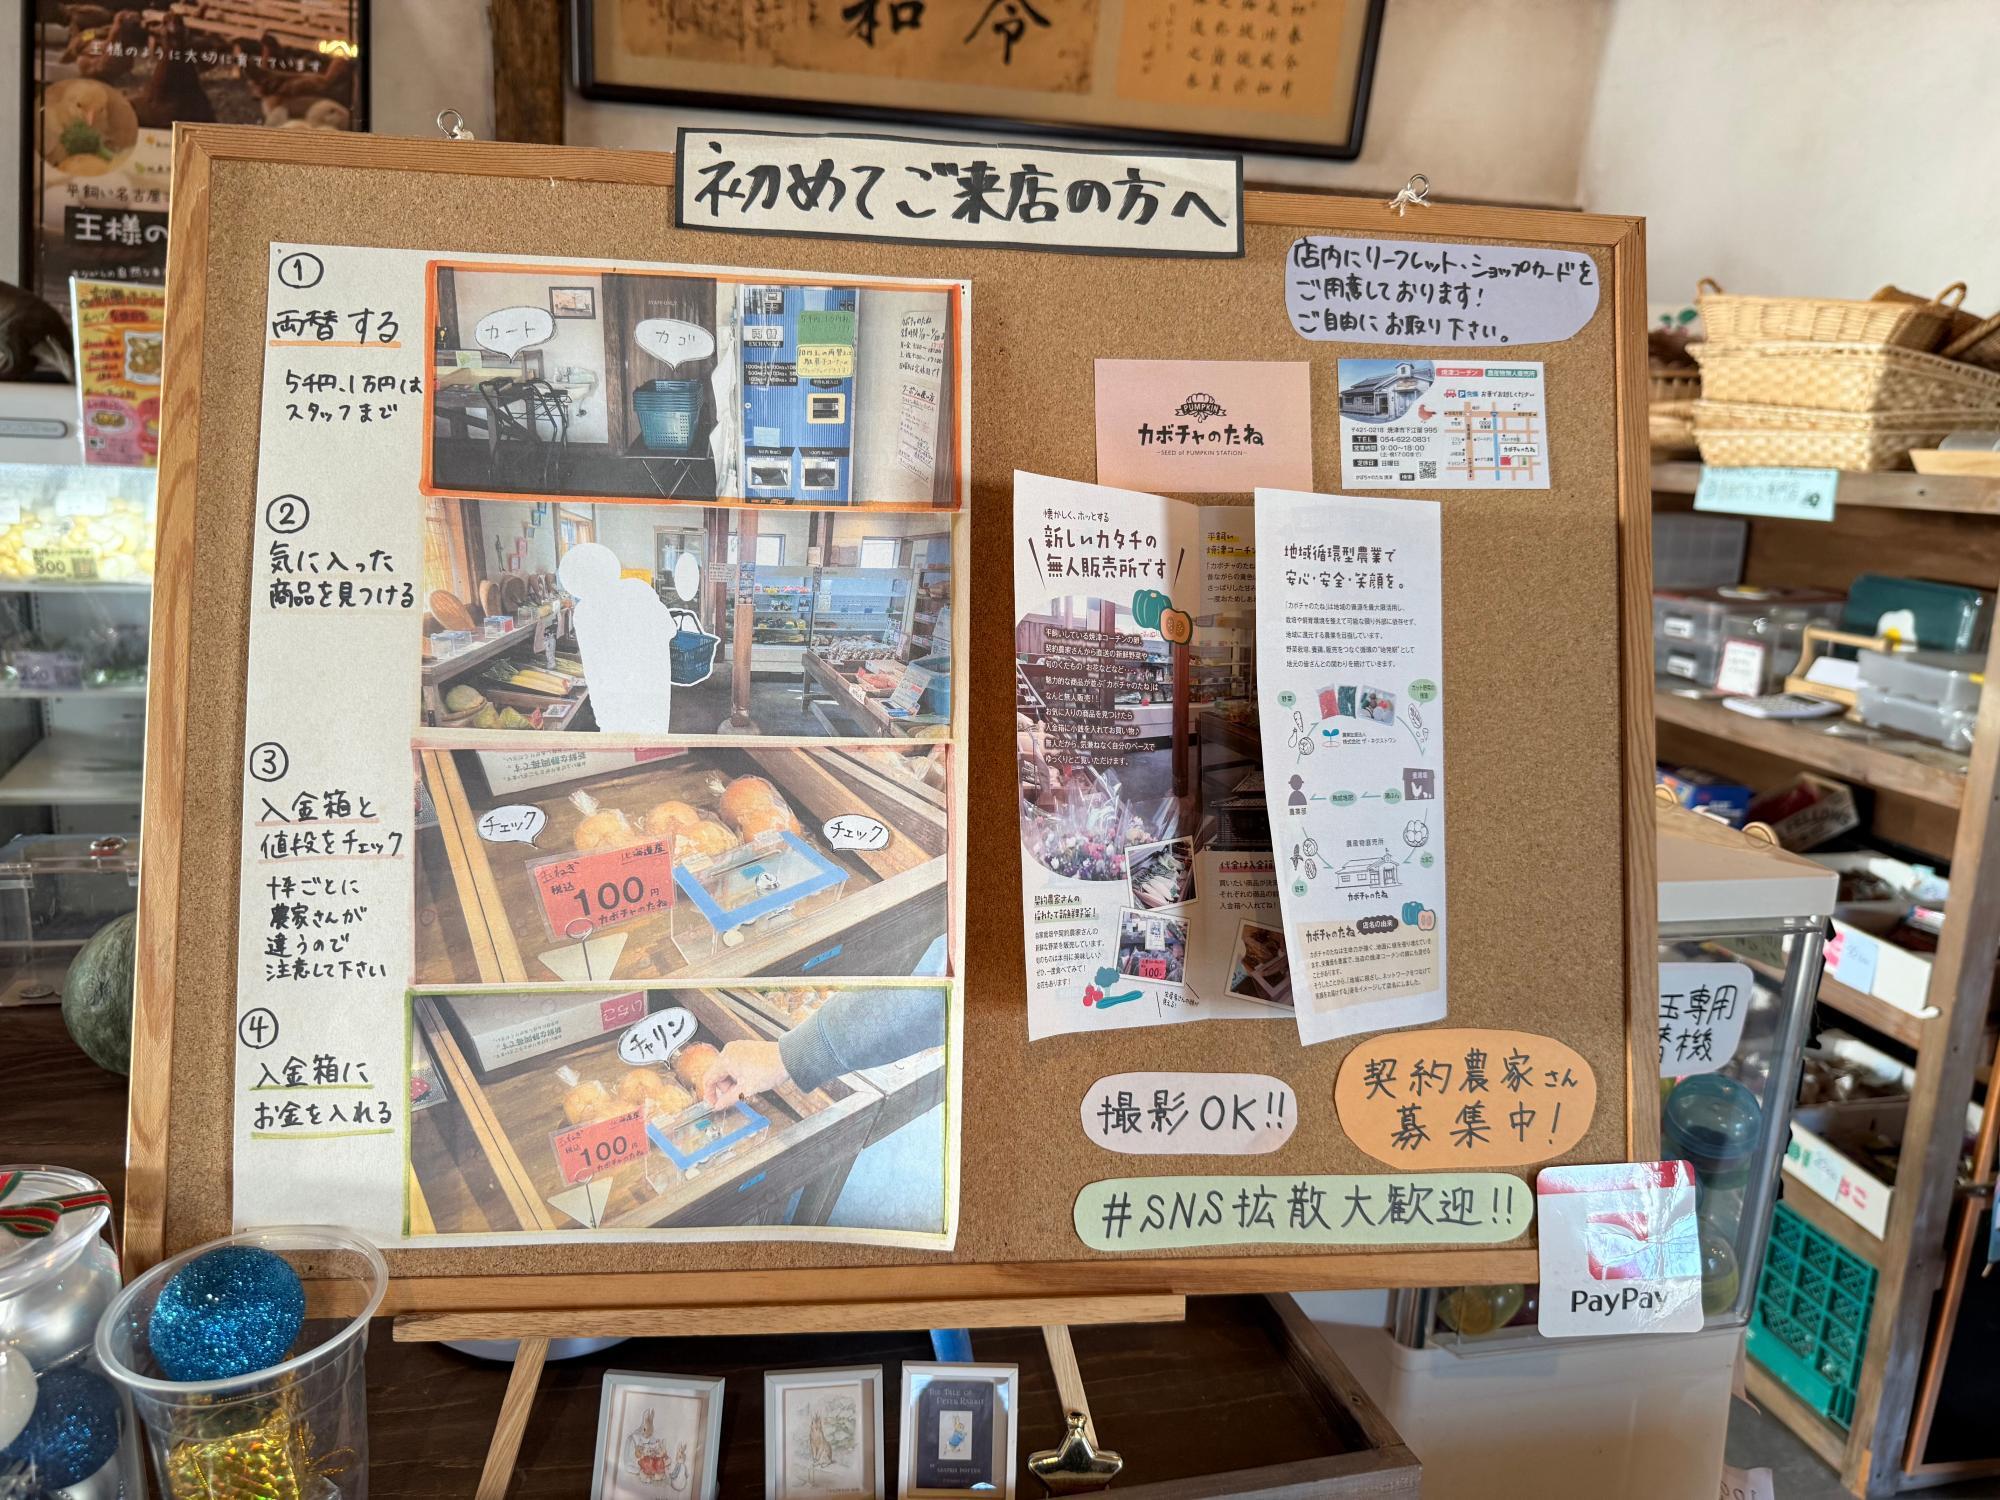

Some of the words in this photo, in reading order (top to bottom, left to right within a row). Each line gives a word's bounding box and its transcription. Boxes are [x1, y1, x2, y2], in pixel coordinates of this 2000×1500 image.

[90, 42, 322, 73] 王様のように大切に育てています
[67, 184, 170, 205] 平飼い名古屋
[695, 141, 1227, 229] 初めてご来店の方へ
[1294, 239, 1594, 286] 店内にリーフレット、ショップカードを
[1296, 272, 1485, 309] ご用意しております!
[272, 308, 399, 344] 両替する
[484, 320, 536, 338] カート
[655, 330, 696, 346] カゴ
[1297, 308, 1510, 343] ご自由にお取り下さい。
[286, 402, 398, 423] スタッフまで
[1183, 403, 1219, 414] PUMPKIN
[1138, 423, 1265, 446] カボチャのたね
[1044, 524, 1157, 550] 新しいカタチの
[270, 541, 394, 574] 気に入った
[1046, 553, 1167, 580] 無人販売所です
[1284, 543, 1397, 563] 地域循環型農業で
[270, 578, 414, 608] 商品を見つける
[1285, 570, 1405, 589] 安心・安全・笑顔を。
[262, 789, 376, 822] 入金箱と
[482, 809, 538, 834] チェック
[829, 819, 884, 842] チェック
[261, 830, 402, 859] 値段をチェック
[266, 876, 360, 900] 枠ごとに
[551, 882, 575, 895] 税込
[574, 876, 644, 916] 100
[650, 888, 660, 896] 円
[1348, 890, 1389, 901] カボチャのたね
[270, 903, 367, 929] 農家さんが
[265, 933, 350, 957] 違うので
[1305, 925, 1356, 943] カボチャのたね
[266, 957, 387, 981] 注意して下さい
[629, 1016, 687, 1059] チャリン
[257, 1054, 369, 1088] 入金箱に
[1363, 1046, 1578, 1096] 契約農家さん
[254, 1101, 392, 1129] お金を入れる
[1391, 1103, 1563, 1150] 募集中!
[580, 1135, 627, 1166] 100
[1571, 1287, 1670, 1317] PayPay
